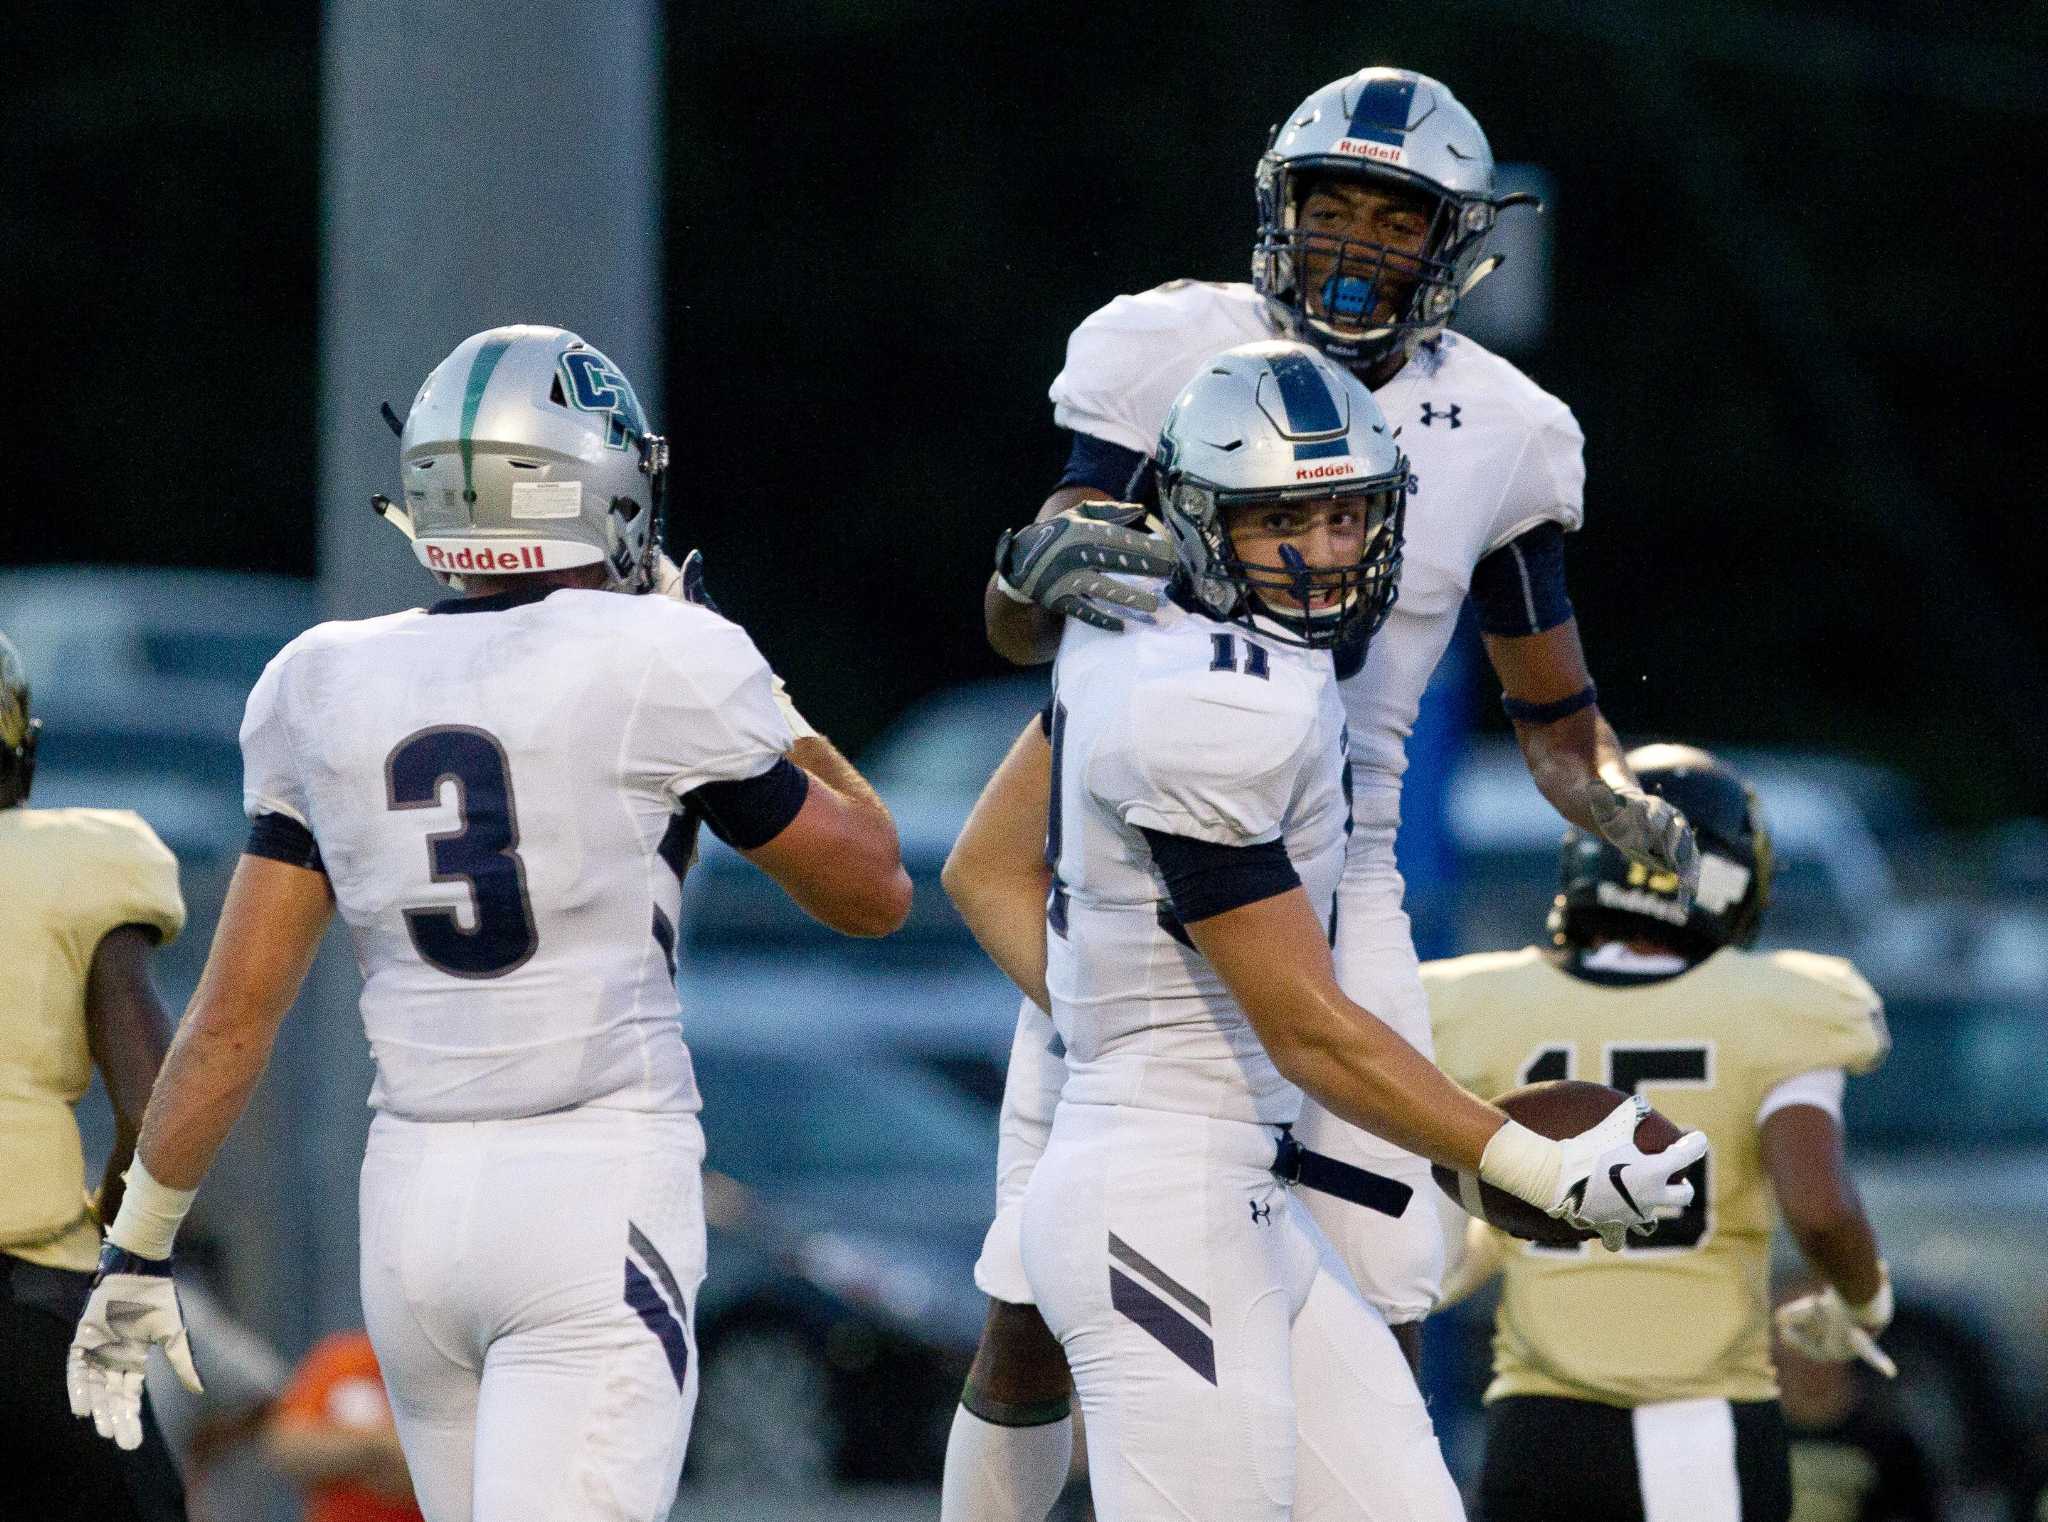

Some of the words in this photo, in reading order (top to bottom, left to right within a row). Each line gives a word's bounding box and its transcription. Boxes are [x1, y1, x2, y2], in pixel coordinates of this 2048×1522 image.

[1340, 141, 1401, 161] Riddell
[425, 544, 545, 570] Riddell
[1209, 632, 1271, 682] 11
[383, 723, 540, 981] 3
